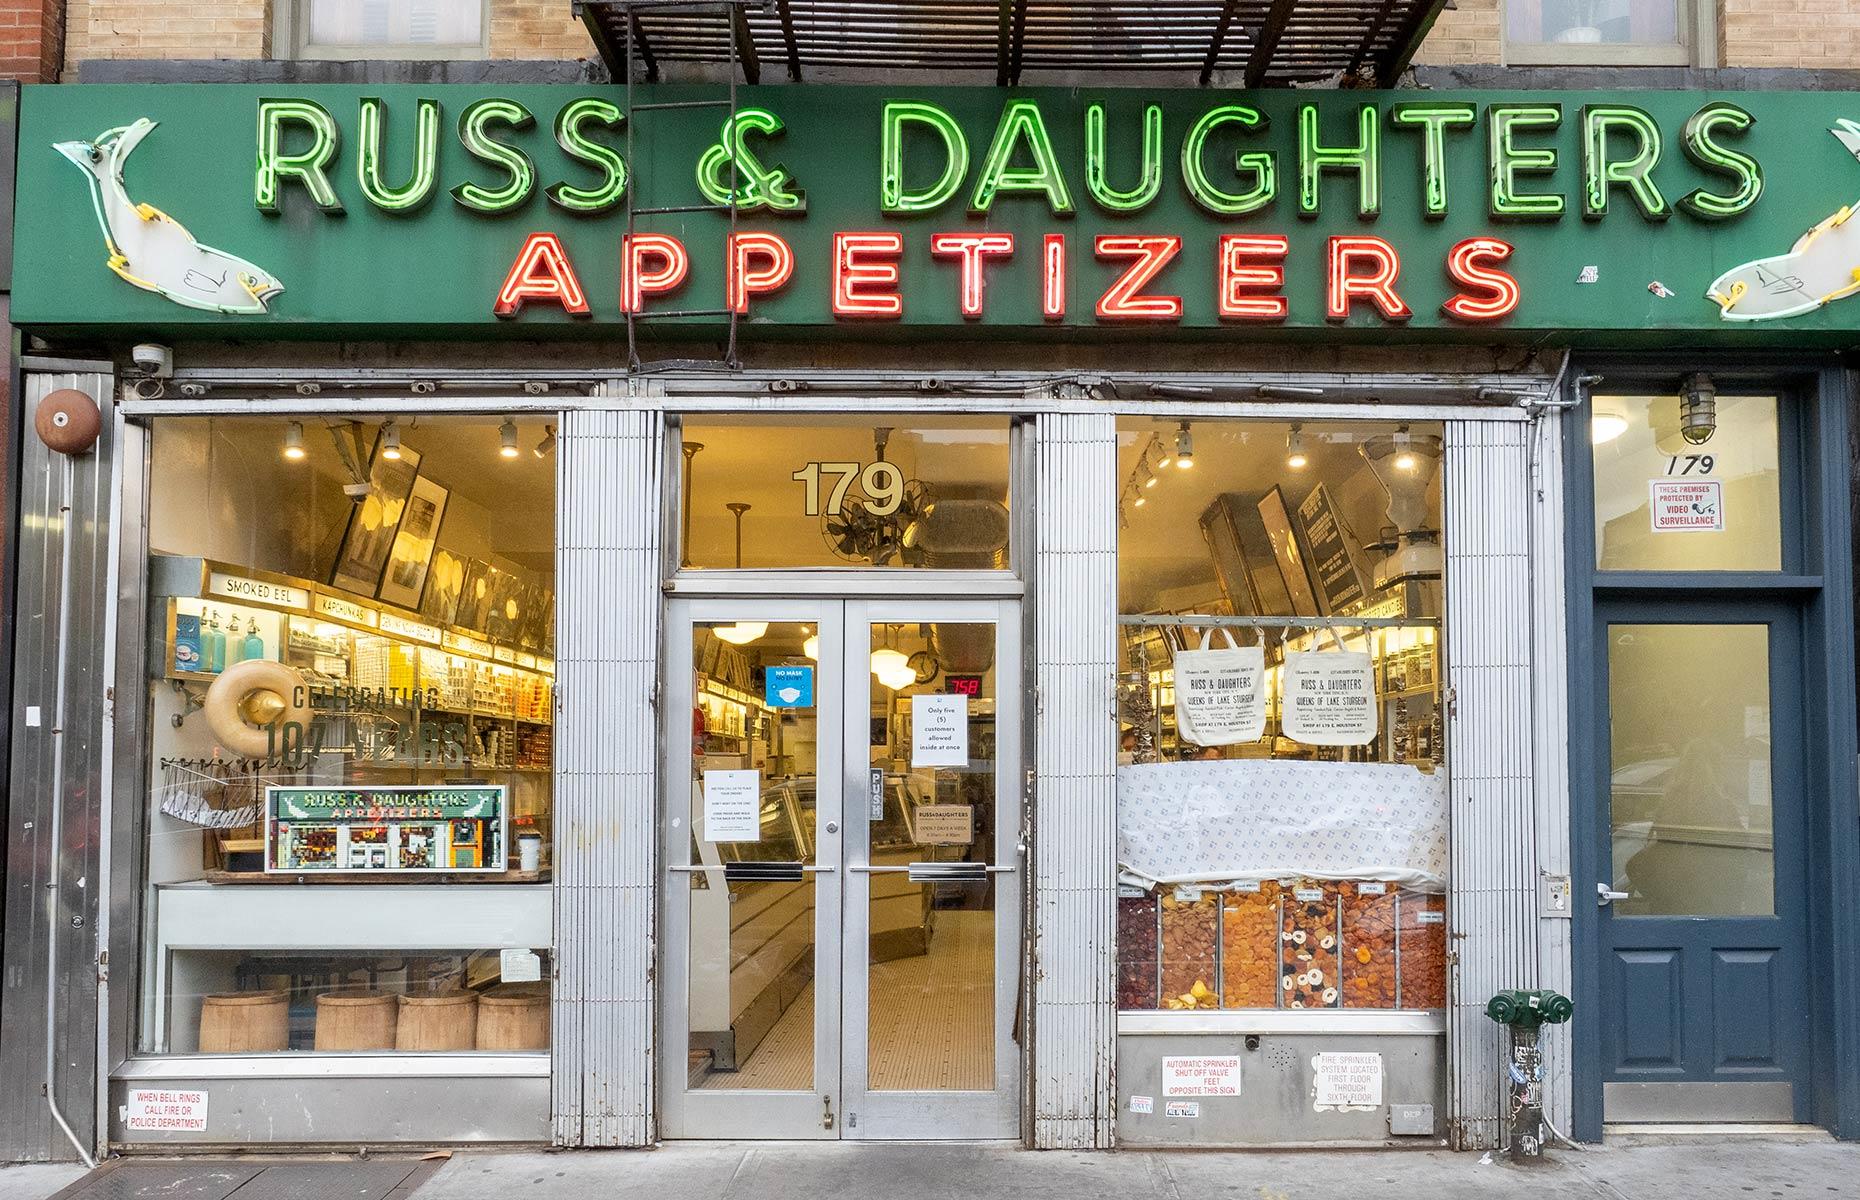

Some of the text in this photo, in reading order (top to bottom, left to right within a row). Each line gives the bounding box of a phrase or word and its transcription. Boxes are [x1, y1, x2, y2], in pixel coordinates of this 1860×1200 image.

[256, 97, 1766, 220] RUSS & DAUGHTERS
[494, 232, 1522, 322] APPETIZERS
[1667, 455, 1714, 476] 179
[792, 460, 905, 517] 179
[1679, 485, 1710, 493] PREMISES
[1666, 505, 1689, 514] VIDEO
[1660, 516, 1715, 525] SURVEILLANCE
[226, 579, 292, 603] SMOKED EEL
[950, 679, 980, 695] 758
[1190, 677, 1252, 690] RUSS & DAUGHTERS
[1300, 678, 1362, 690] RUSS & DAUGHTERS
[293, 685, 439, 710] CELEBRATING
[1187, 694, 1255, 706] QUEENS OF LAKE STURGEON
[1296, 696, 1368, 706] QUEENS OF LAKE STURGEON
[936, 716, 947, 724] (5)
[264, 721, 467, 770] 107 YEARS
[303, 792, 347, 807] RUSS
[373, 792, 470, 807] DAUGHTERS
[872, 773, 881, 817] PUSH
[331, 808, 443, 818] APPETIZERS
[1166, 1060, 1238, 1068] AUTOMATIC SPRINKLER
[1321, 1056, 1377, 1064] FIRE SPRINKLER
[1175, 1069, 1229, 1077] SHUT OFF VALVE
[1321, 1065, 1379, 1073] SYSTEM LOCATED
[137, 1092, 201, 1103] WHEN BELL RINGS
[1327, 1093, 1372, 1101] SIXTH FLOOR
[144, 1105, 192, 1116] CALL FIRE OR
[130, 1117, 204, 1128] POLICE DEPARTMENT
